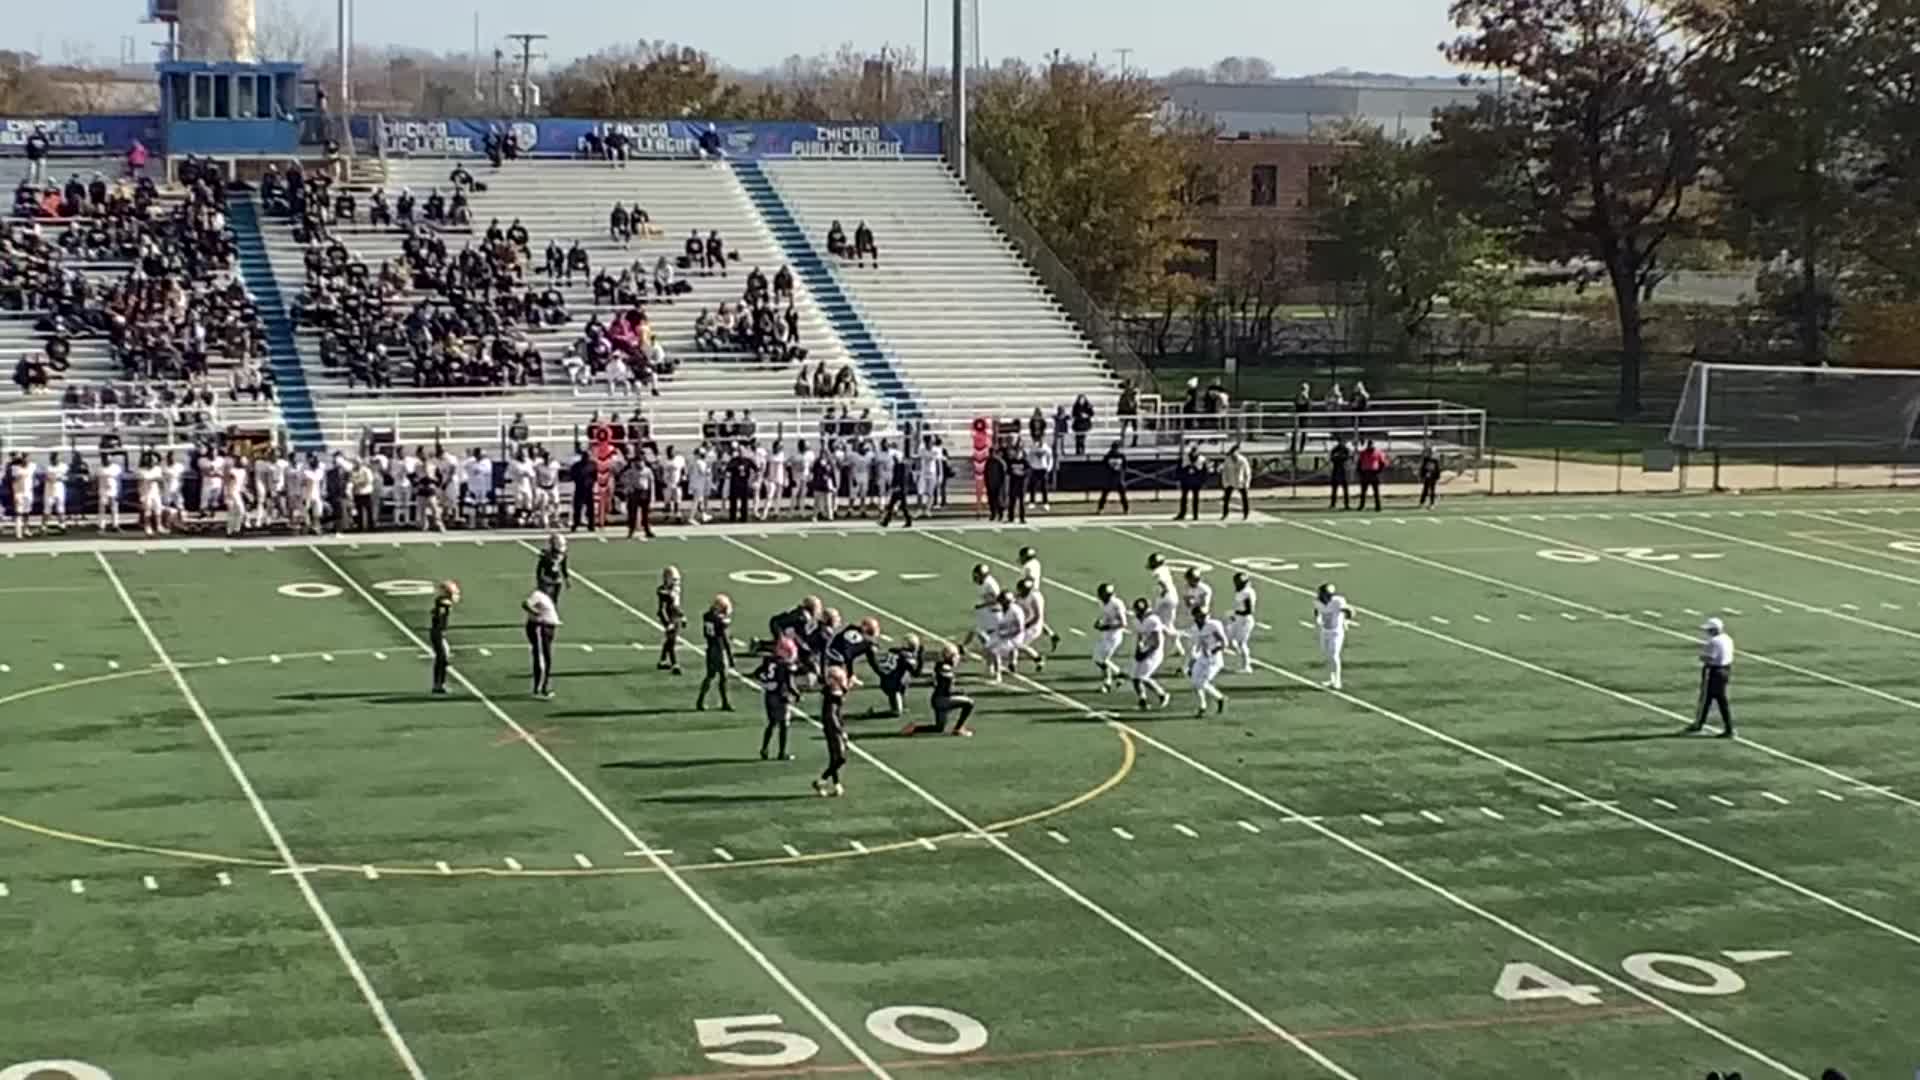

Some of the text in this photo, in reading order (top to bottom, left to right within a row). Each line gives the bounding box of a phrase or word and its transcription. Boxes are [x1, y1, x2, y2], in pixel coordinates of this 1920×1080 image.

[816, 126, 880, 141] CHICAGO
[791, 141, 904, 156] PUBLIC LEAGUE
